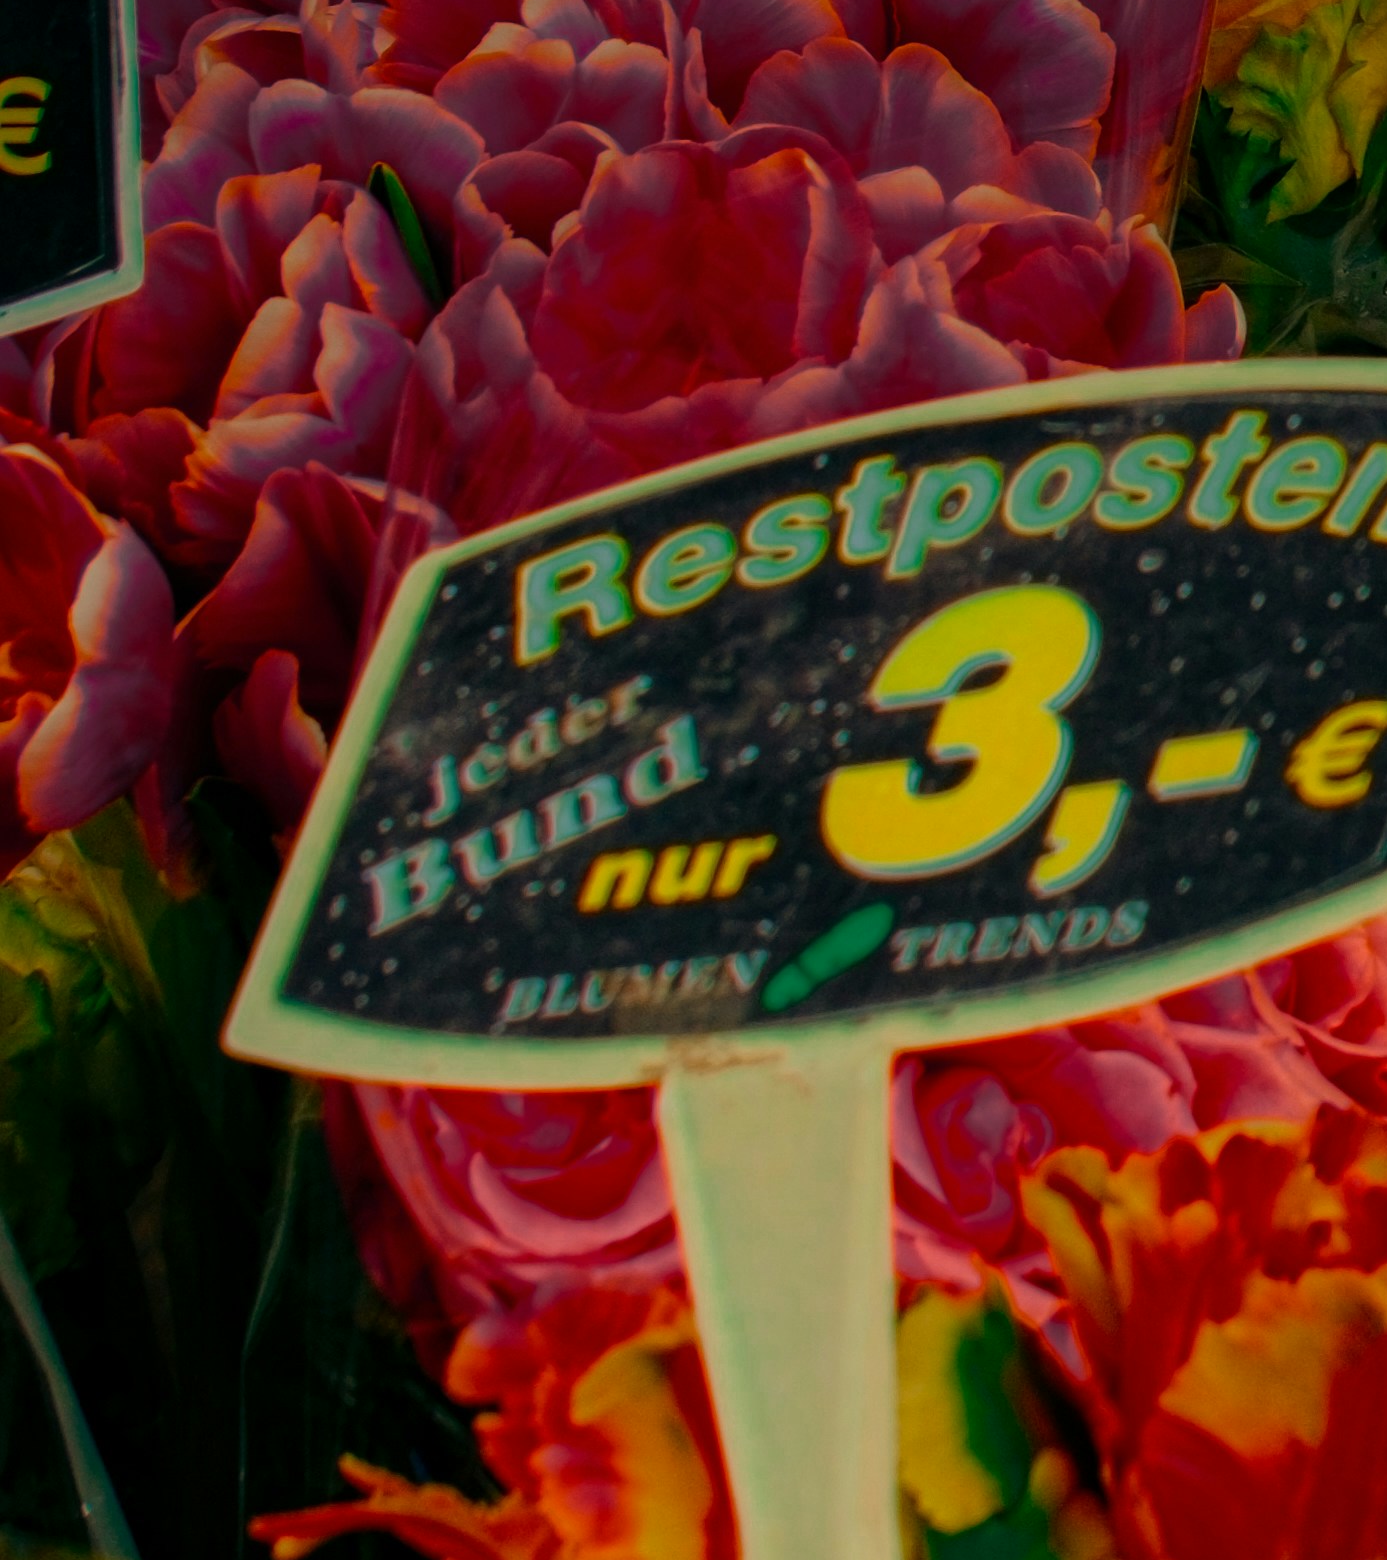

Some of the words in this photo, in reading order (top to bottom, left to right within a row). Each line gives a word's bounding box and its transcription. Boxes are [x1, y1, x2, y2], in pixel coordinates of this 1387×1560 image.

[367, 713, 706, 938] Bund
[577, 832, 782, 915] nur
[499, 948, 772, 1027] BLUMEN
[891, 897, 1154, 972] TRENDS
